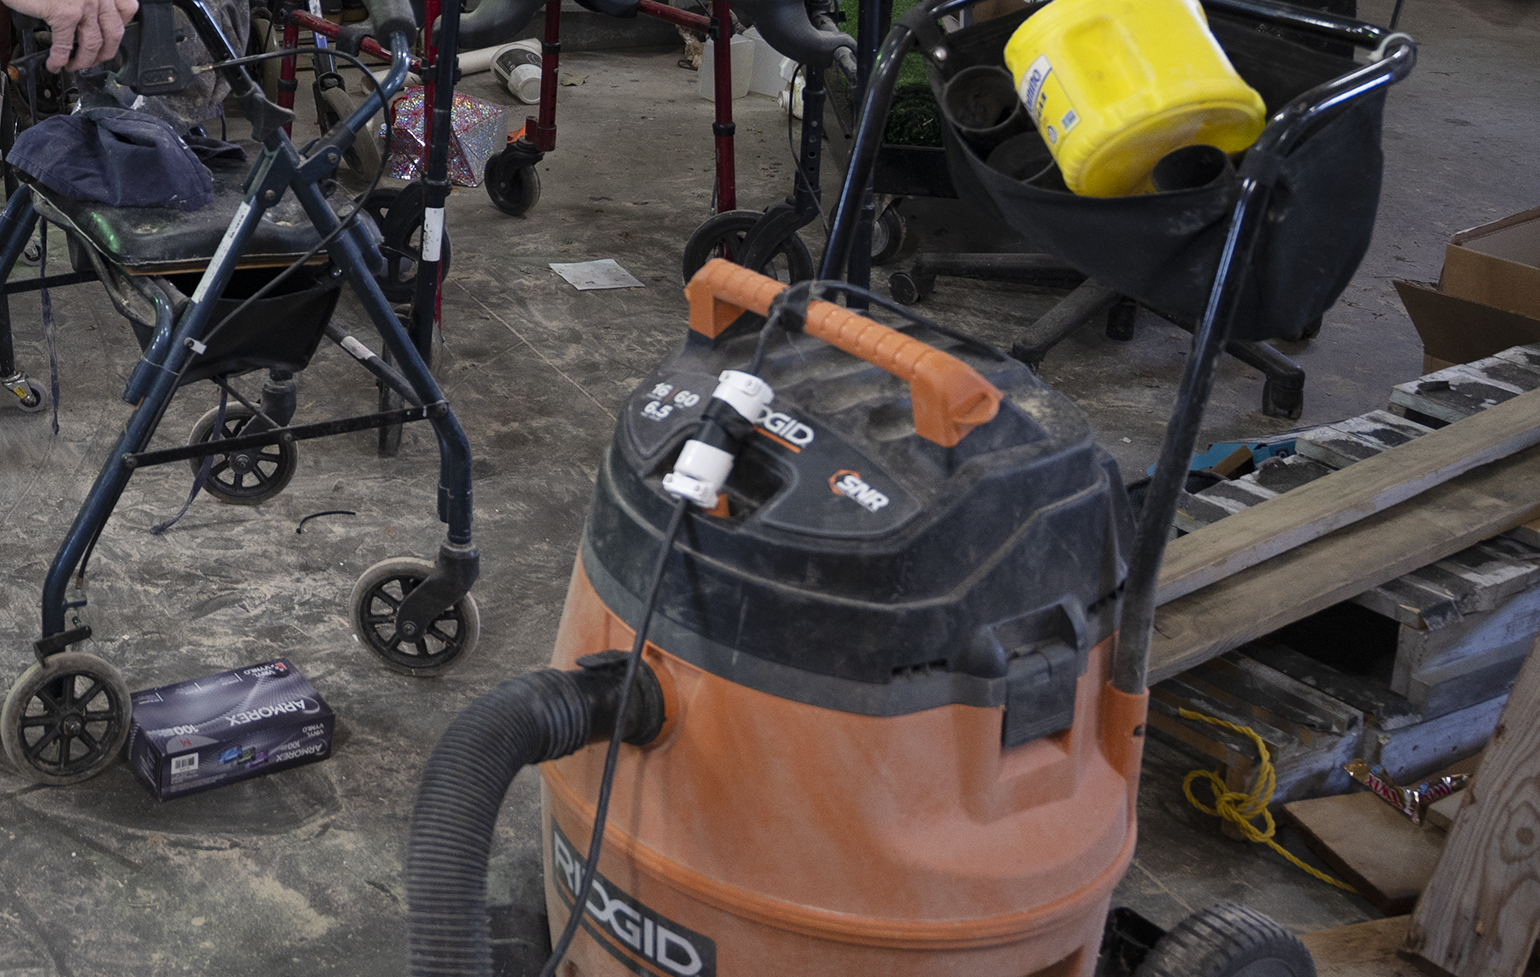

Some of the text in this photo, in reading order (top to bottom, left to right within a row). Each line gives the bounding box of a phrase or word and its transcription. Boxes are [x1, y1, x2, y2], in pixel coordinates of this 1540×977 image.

[651, 381, 701, 408] 16 60
[643, 400, 674, 421] 6.5
[836, 474, 890, 514] SNR
[224, 699, 308, 727] ARMOREX
[173, 723, 200, 736] 100
[179, 737, 193, 747] M
[275, 742, 324, 763] ARMOREX
[287, 740, 301, 750] 100
[1363, 773, 1403, 810] TWIX
